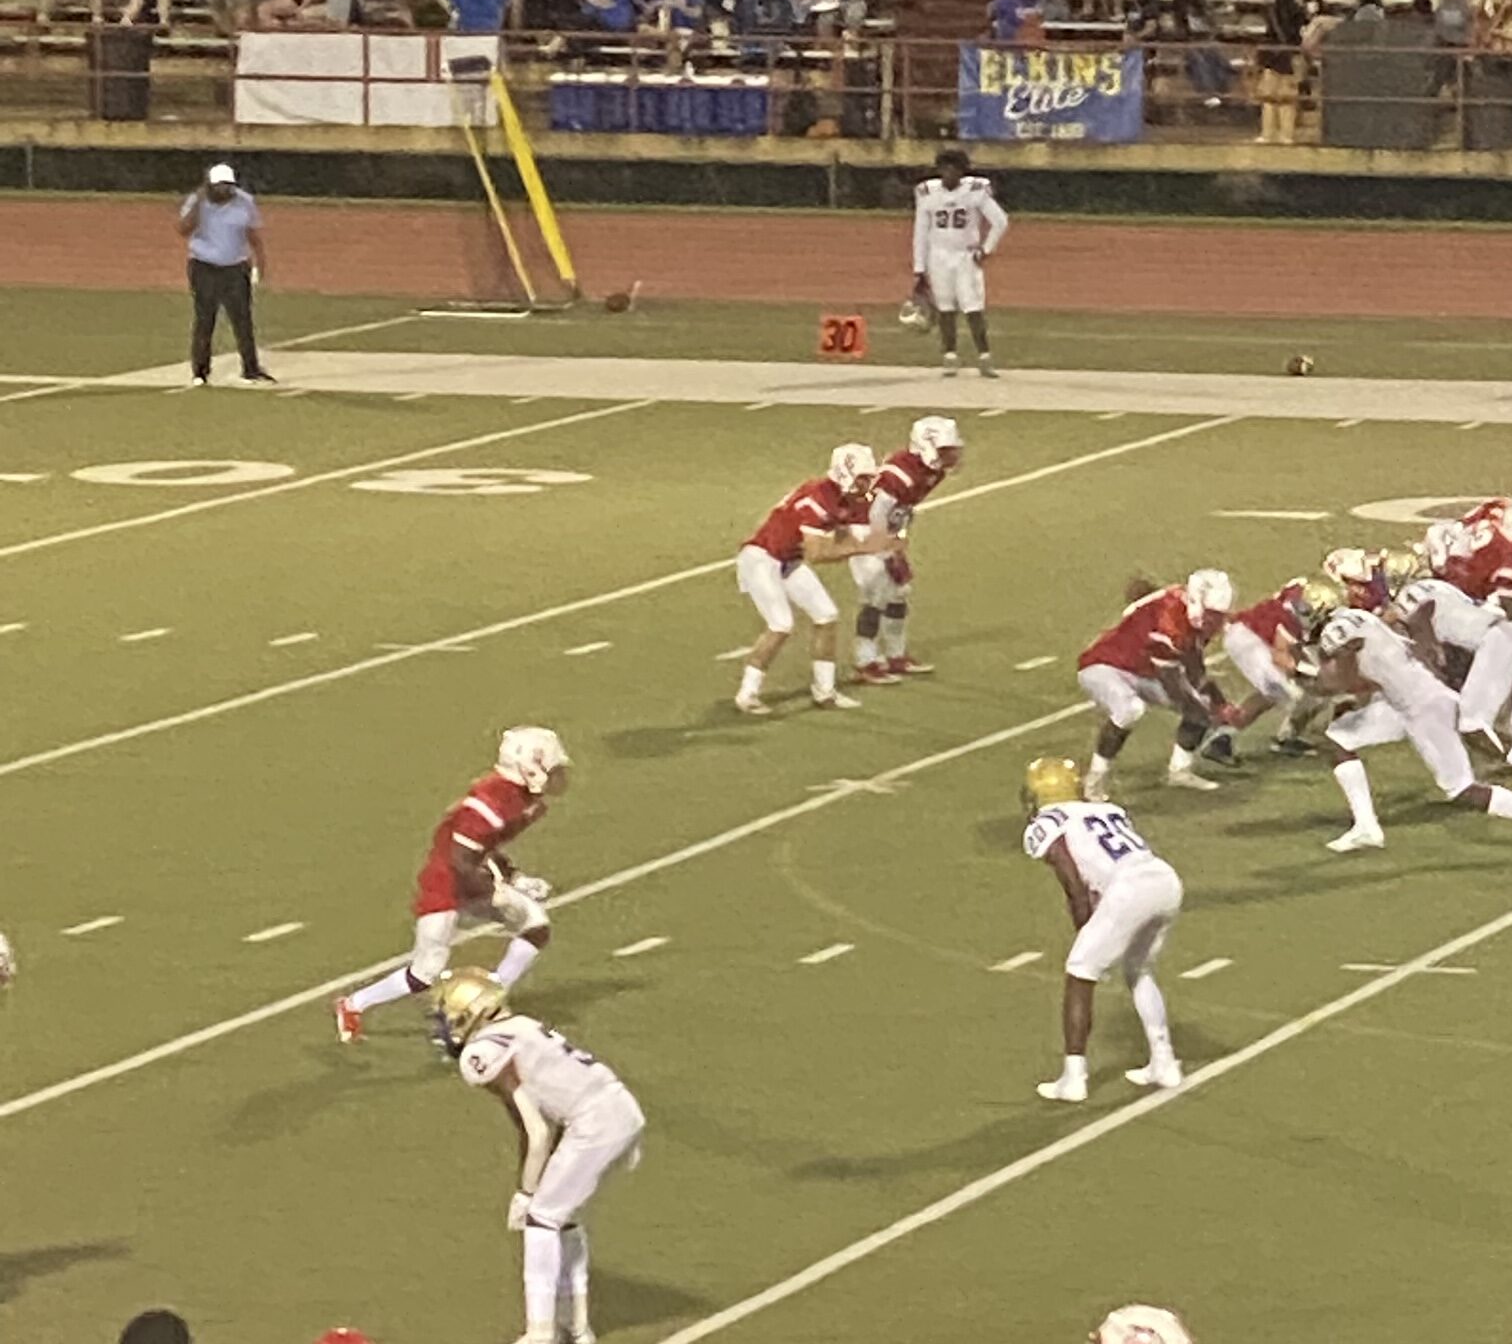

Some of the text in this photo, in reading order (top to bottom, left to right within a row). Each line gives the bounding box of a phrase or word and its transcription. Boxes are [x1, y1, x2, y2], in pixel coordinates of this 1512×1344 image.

[979, 49, 1122, 96] ELKINS
[1003, 81, 1090, 119] Elite
[822, 319, 858, 352] 30
[1083, 812, 1149, 861] 20
